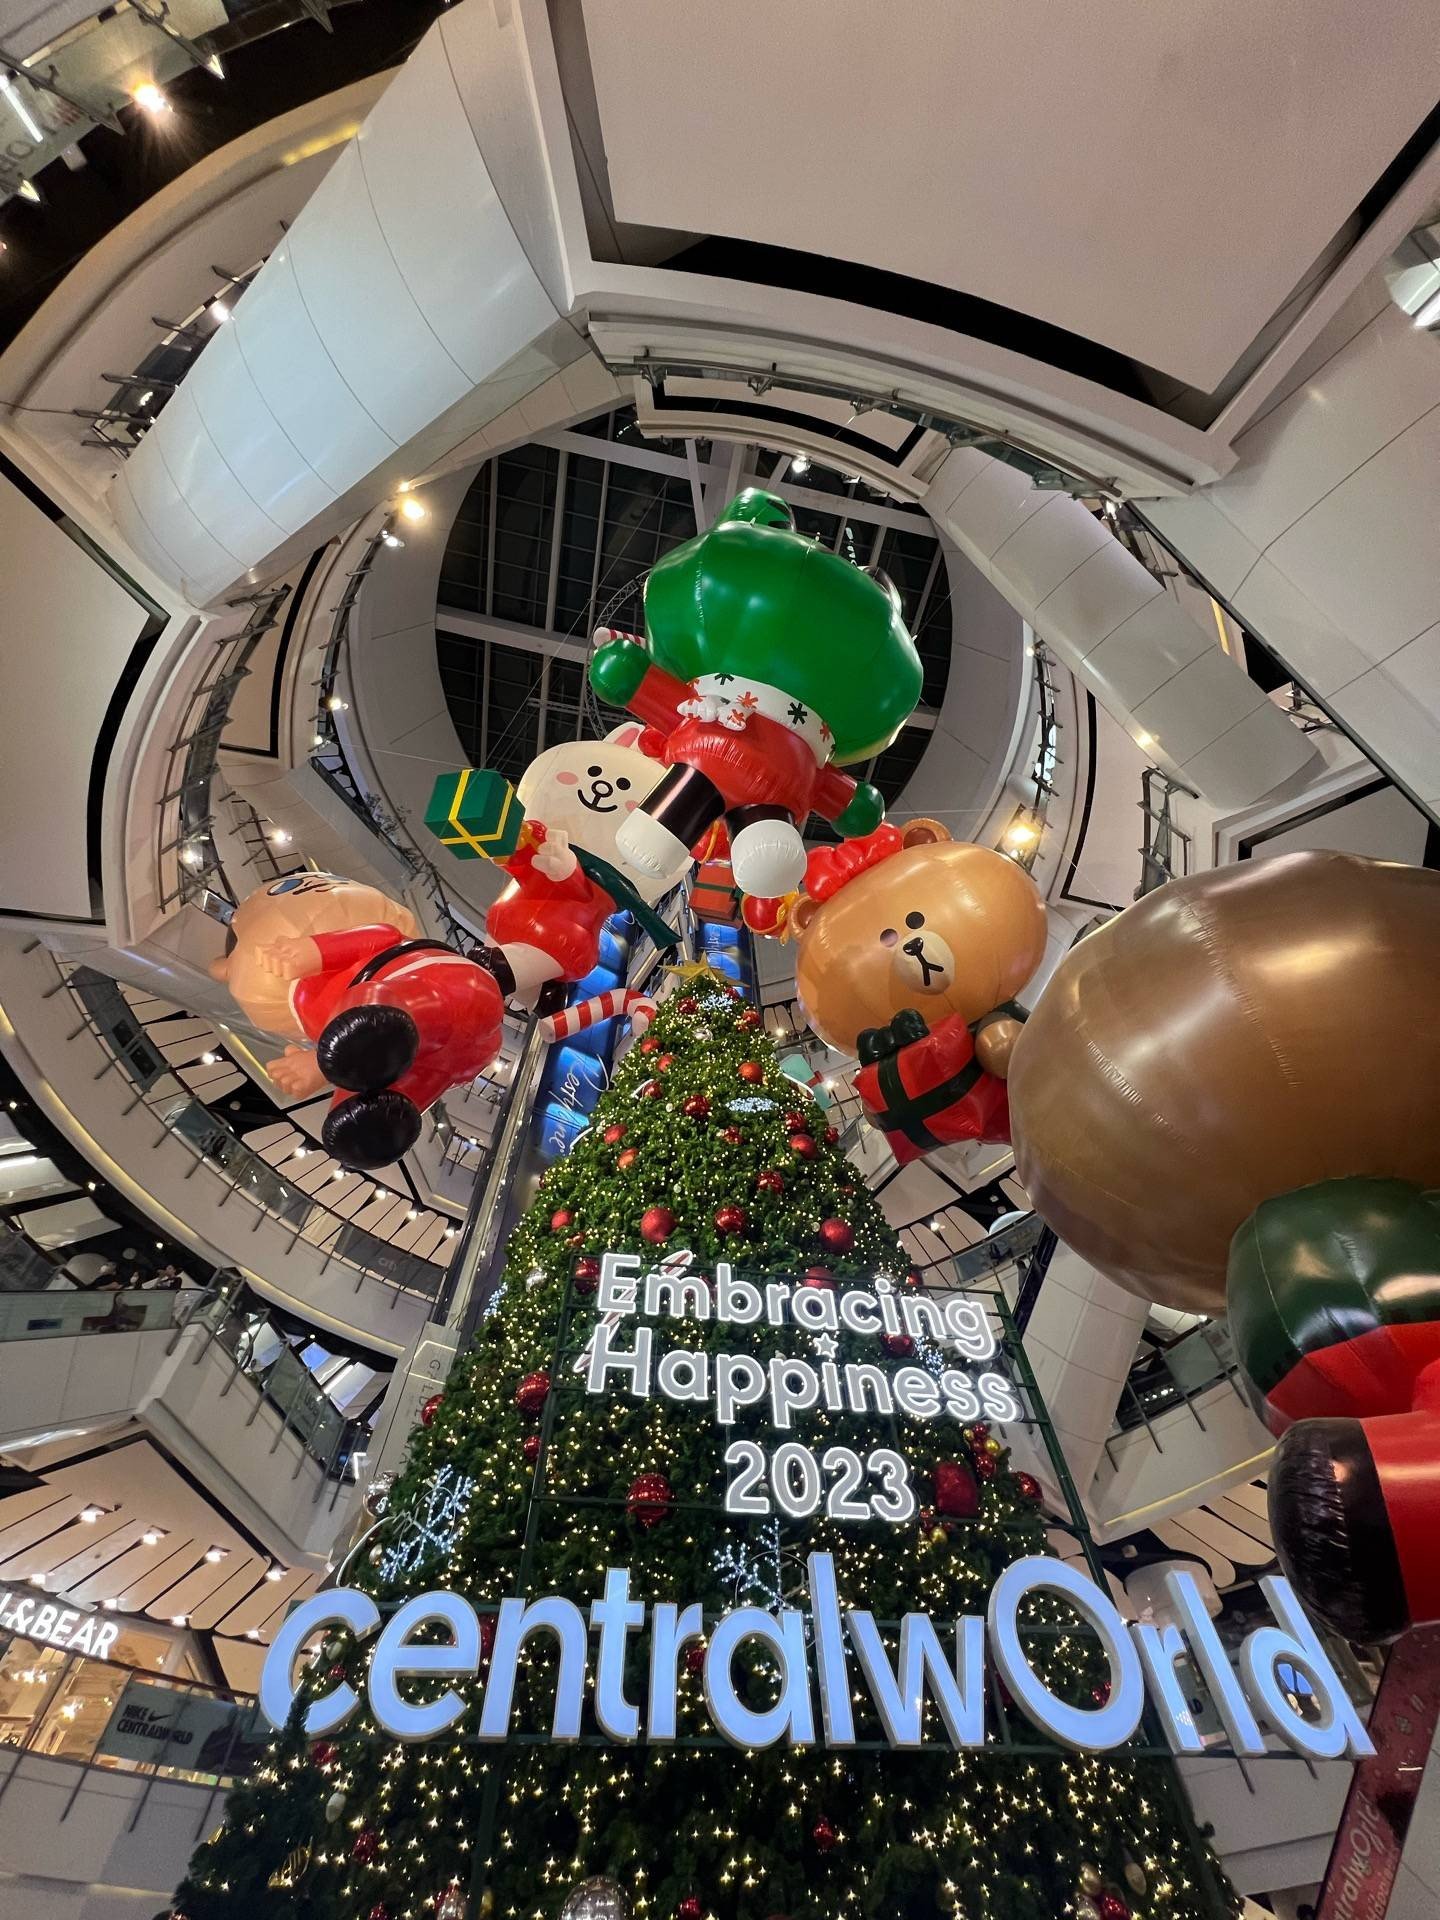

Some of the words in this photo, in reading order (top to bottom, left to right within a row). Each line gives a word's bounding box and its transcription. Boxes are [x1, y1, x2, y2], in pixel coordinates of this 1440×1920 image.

[547, 1053, 610, 1154] Restylne
[597, 1252, 1000, 1361] Embracing
[586, 1323, 1021, 1429] Happiness
[723, 1439, 918, 1522] 2023
[258, 1551, 1378, 1761] centralwOrld
[122, 1703, 148, 1720] NIKE
